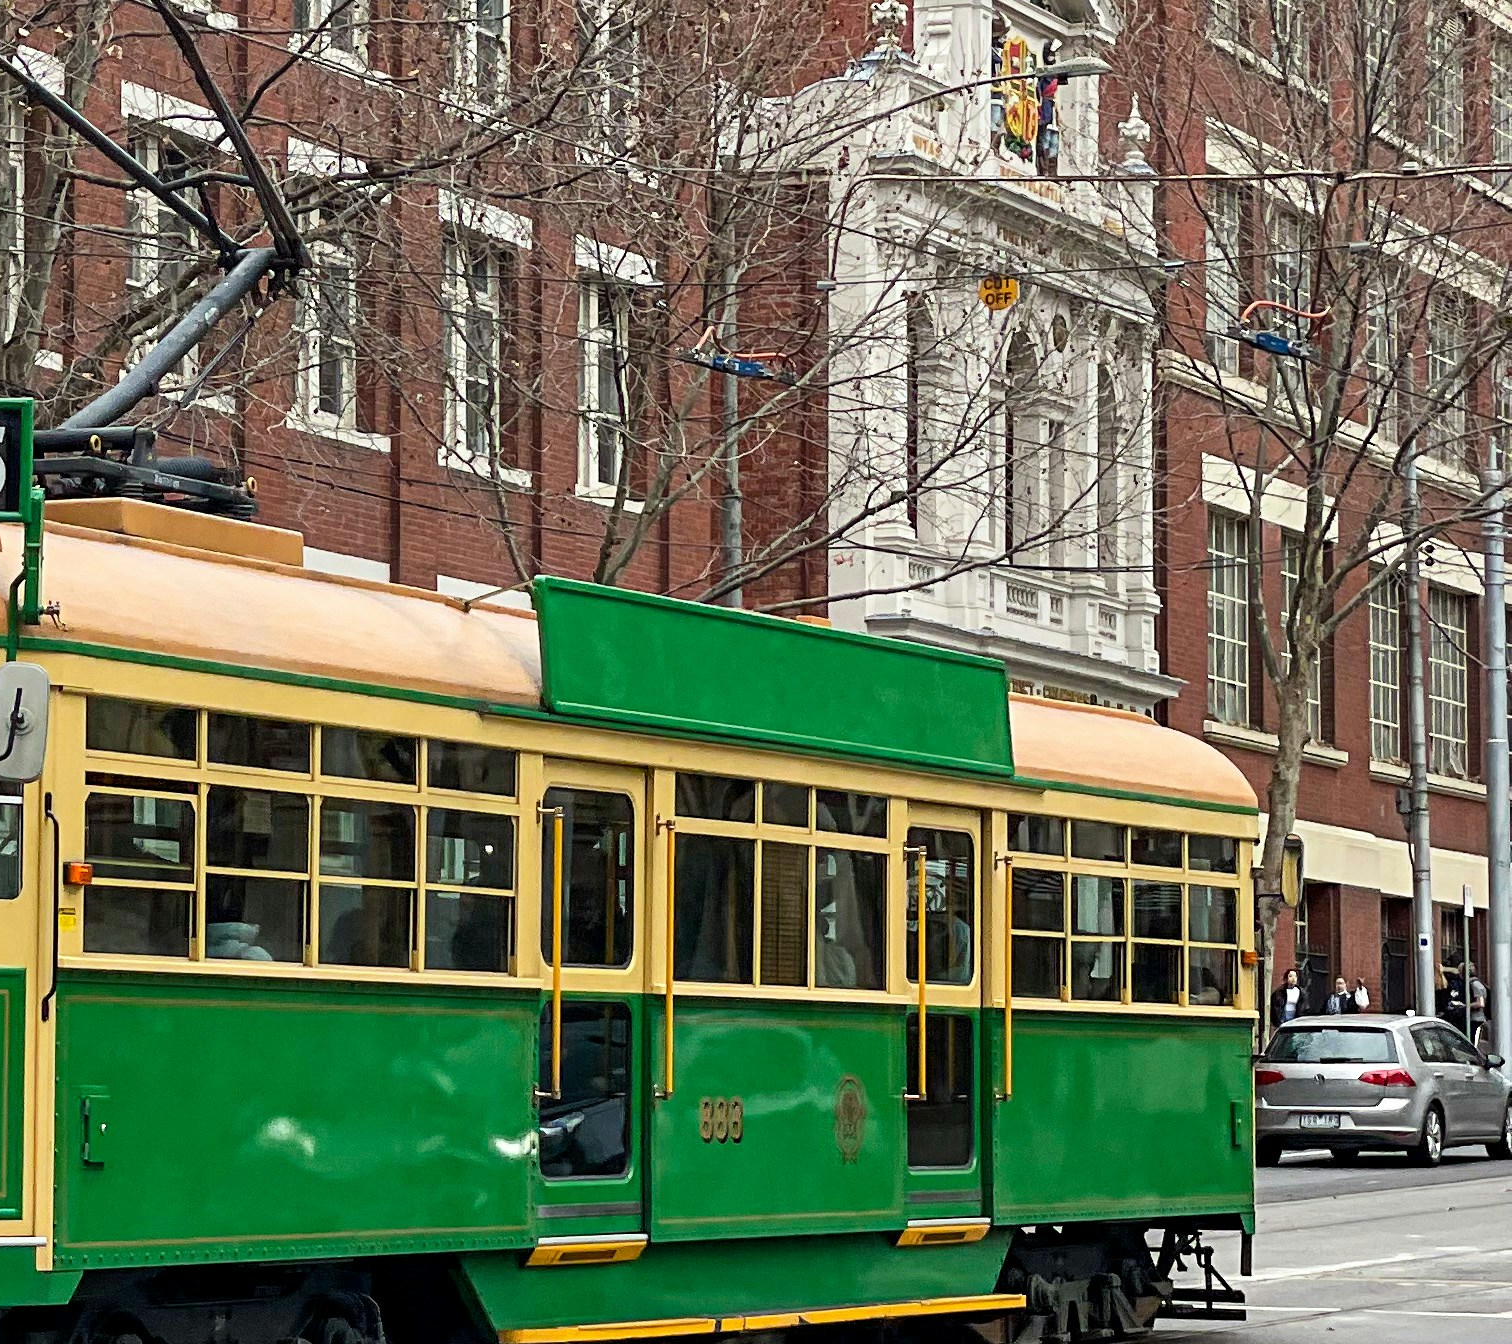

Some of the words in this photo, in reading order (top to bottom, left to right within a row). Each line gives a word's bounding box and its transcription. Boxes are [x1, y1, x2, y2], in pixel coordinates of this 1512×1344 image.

[984, 276, 1012, 290] CUT
[985, 292, 1013, 305] OFF
[699, 1096, 744, 1143] 888
